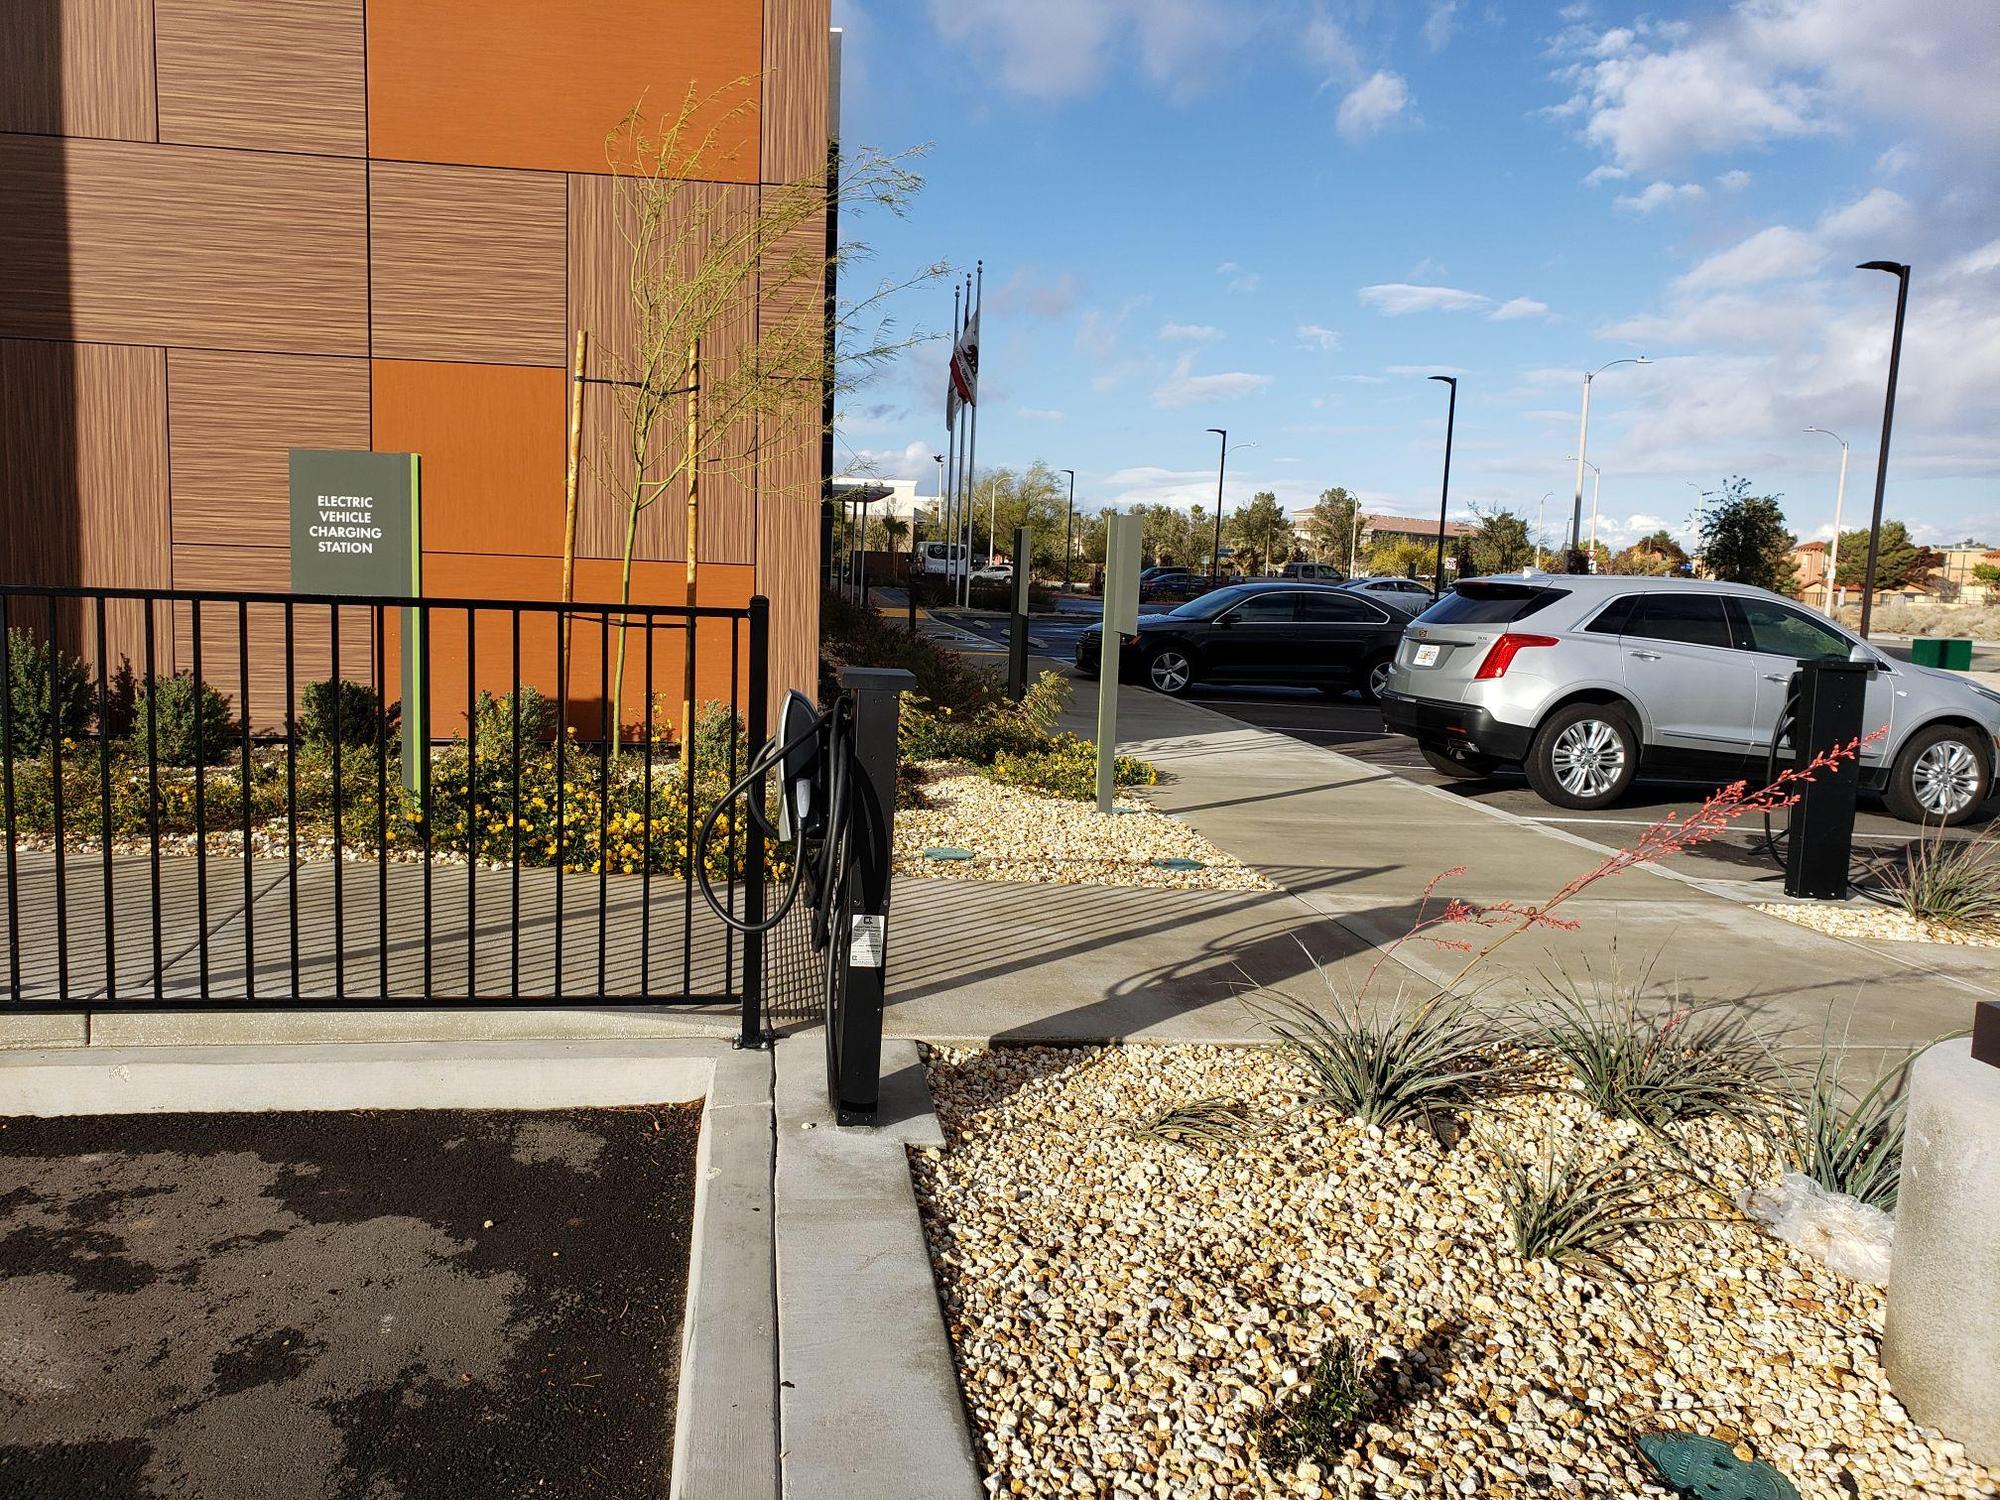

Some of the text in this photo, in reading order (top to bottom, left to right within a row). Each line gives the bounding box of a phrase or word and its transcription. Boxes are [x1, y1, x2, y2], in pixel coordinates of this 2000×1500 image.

[317, 495, 373, 508] ELECTRIC
[319, 511, 372, 524] VEHICLE
[309, 525, 382, 539] CHARGING
[318, 541, 373, 554] STATION
